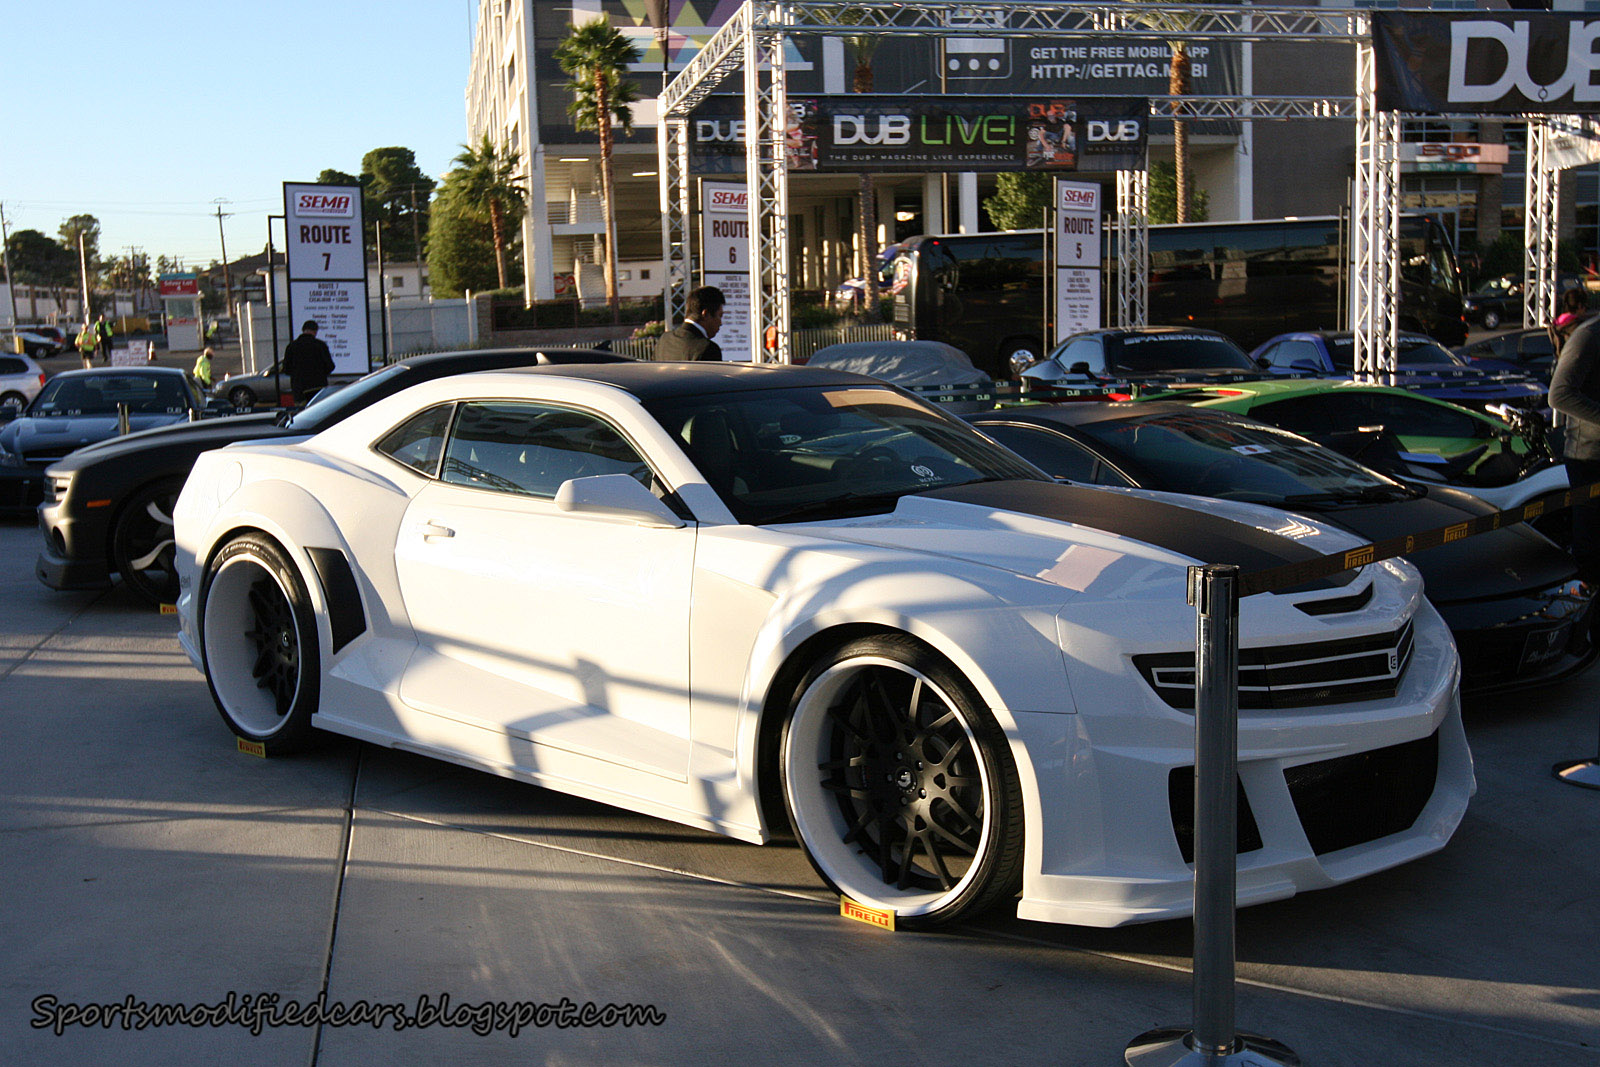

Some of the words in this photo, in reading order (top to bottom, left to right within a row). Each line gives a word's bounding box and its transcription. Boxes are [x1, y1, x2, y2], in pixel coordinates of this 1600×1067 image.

[1030, 47, 1057, 59] GET
[1060, 47, 1088, 59] THE
[1091, 47, 1125, 58] FREE
[1187, 46, 1210, 58] APP
[1031, 63, 1208, 79] HTTP://GETTAG.MBI
[833, 115, 911, 144] DUB
[921, 115, 1015, 145] LIVE!
[1088, 120, 1139, 141] DUB
[299, 195, 350, 209] SEMA
[1064, 190, 1095, 203] SEMA
[300, 224, 351, 244] ROUTE
[1064, 216, 1094, 235] ROUTE
[728, 246, 737, 264] 6
[1076, 242, 1082, 259] 5
[322, 252, 331, 271] 7
[1443, 522, 1469, 544] PIRELLI
[1344, 545, 1374, 570] PIRELLI
[239, 740, 263, 755] PIRELLI
[844, 901, 889, 927] PIRELLI
